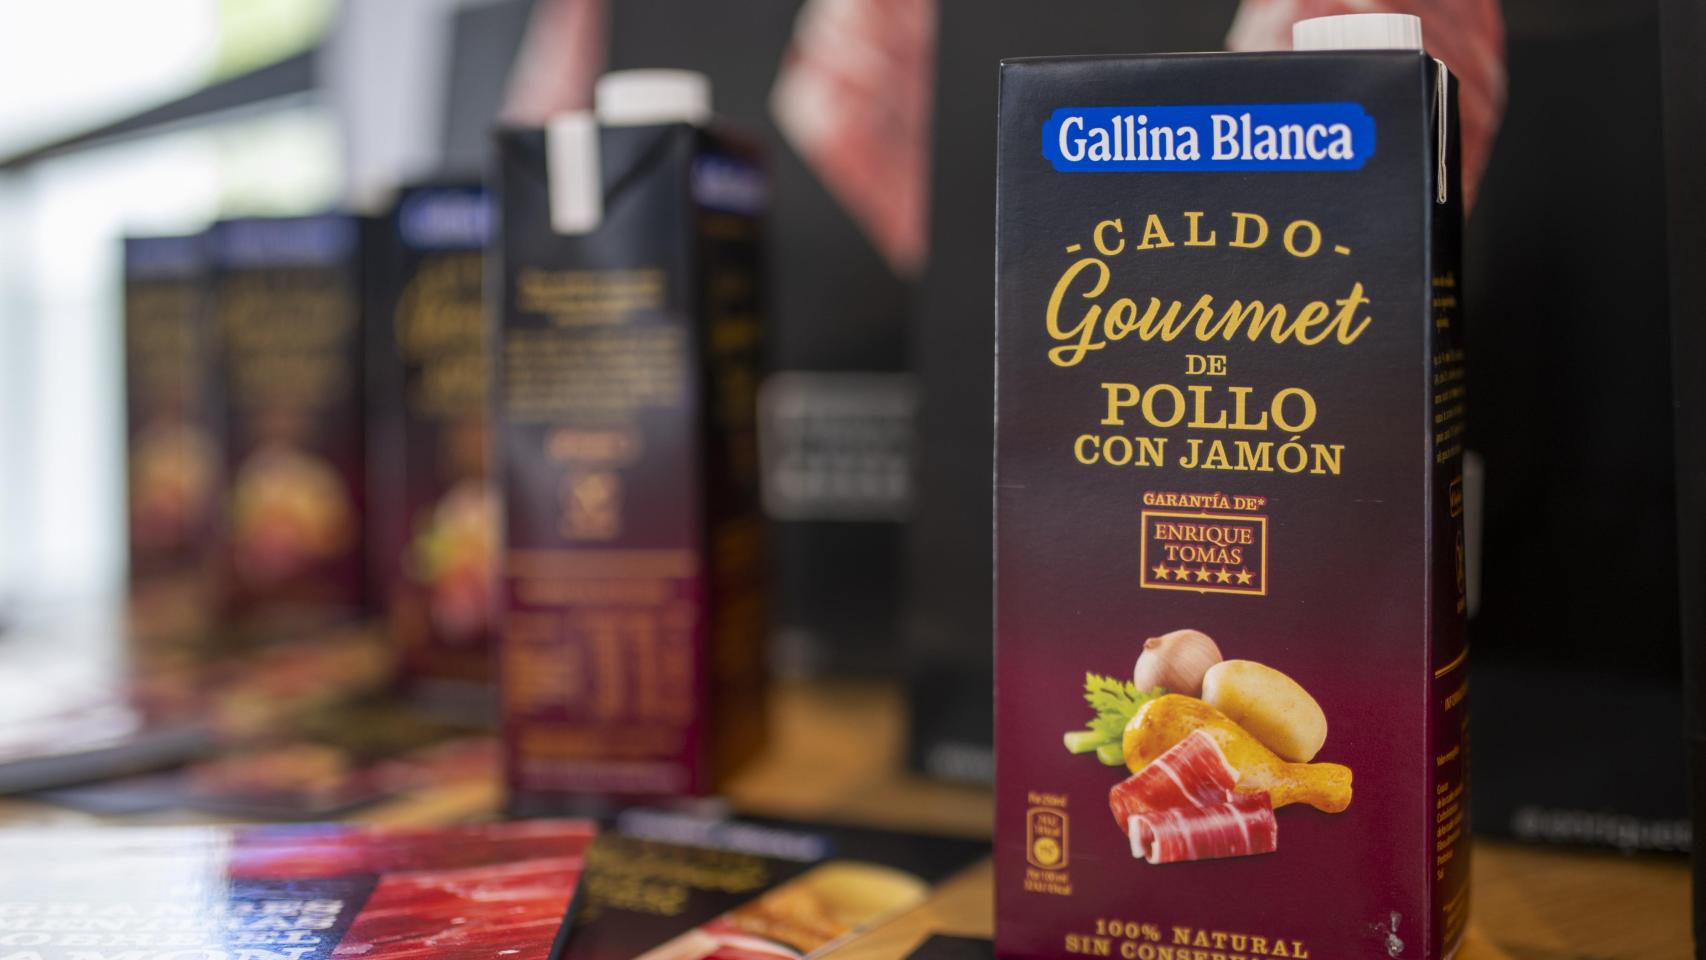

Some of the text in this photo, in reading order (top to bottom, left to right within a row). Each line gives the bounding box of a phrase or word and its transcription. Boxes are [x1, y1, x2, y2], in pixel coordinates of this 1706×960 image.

[1058, 112, 1354, 161] Gallina Blanca
[1046, 257, 1372, 367] Gourmet
[1185, 354, 1227, 376] DE
[1100, 382, 1317, 433] POLLO
[1073, 434, 1345, 475] CON JAMÓN
[1142, 491, 1231, 510] GARANTÍA
[1154, 523, 1253, 547] ENRIQUE
[1065, 933, 1111, 956] SIN
[1096, 919, 1309, 960] 100% NATURAL
